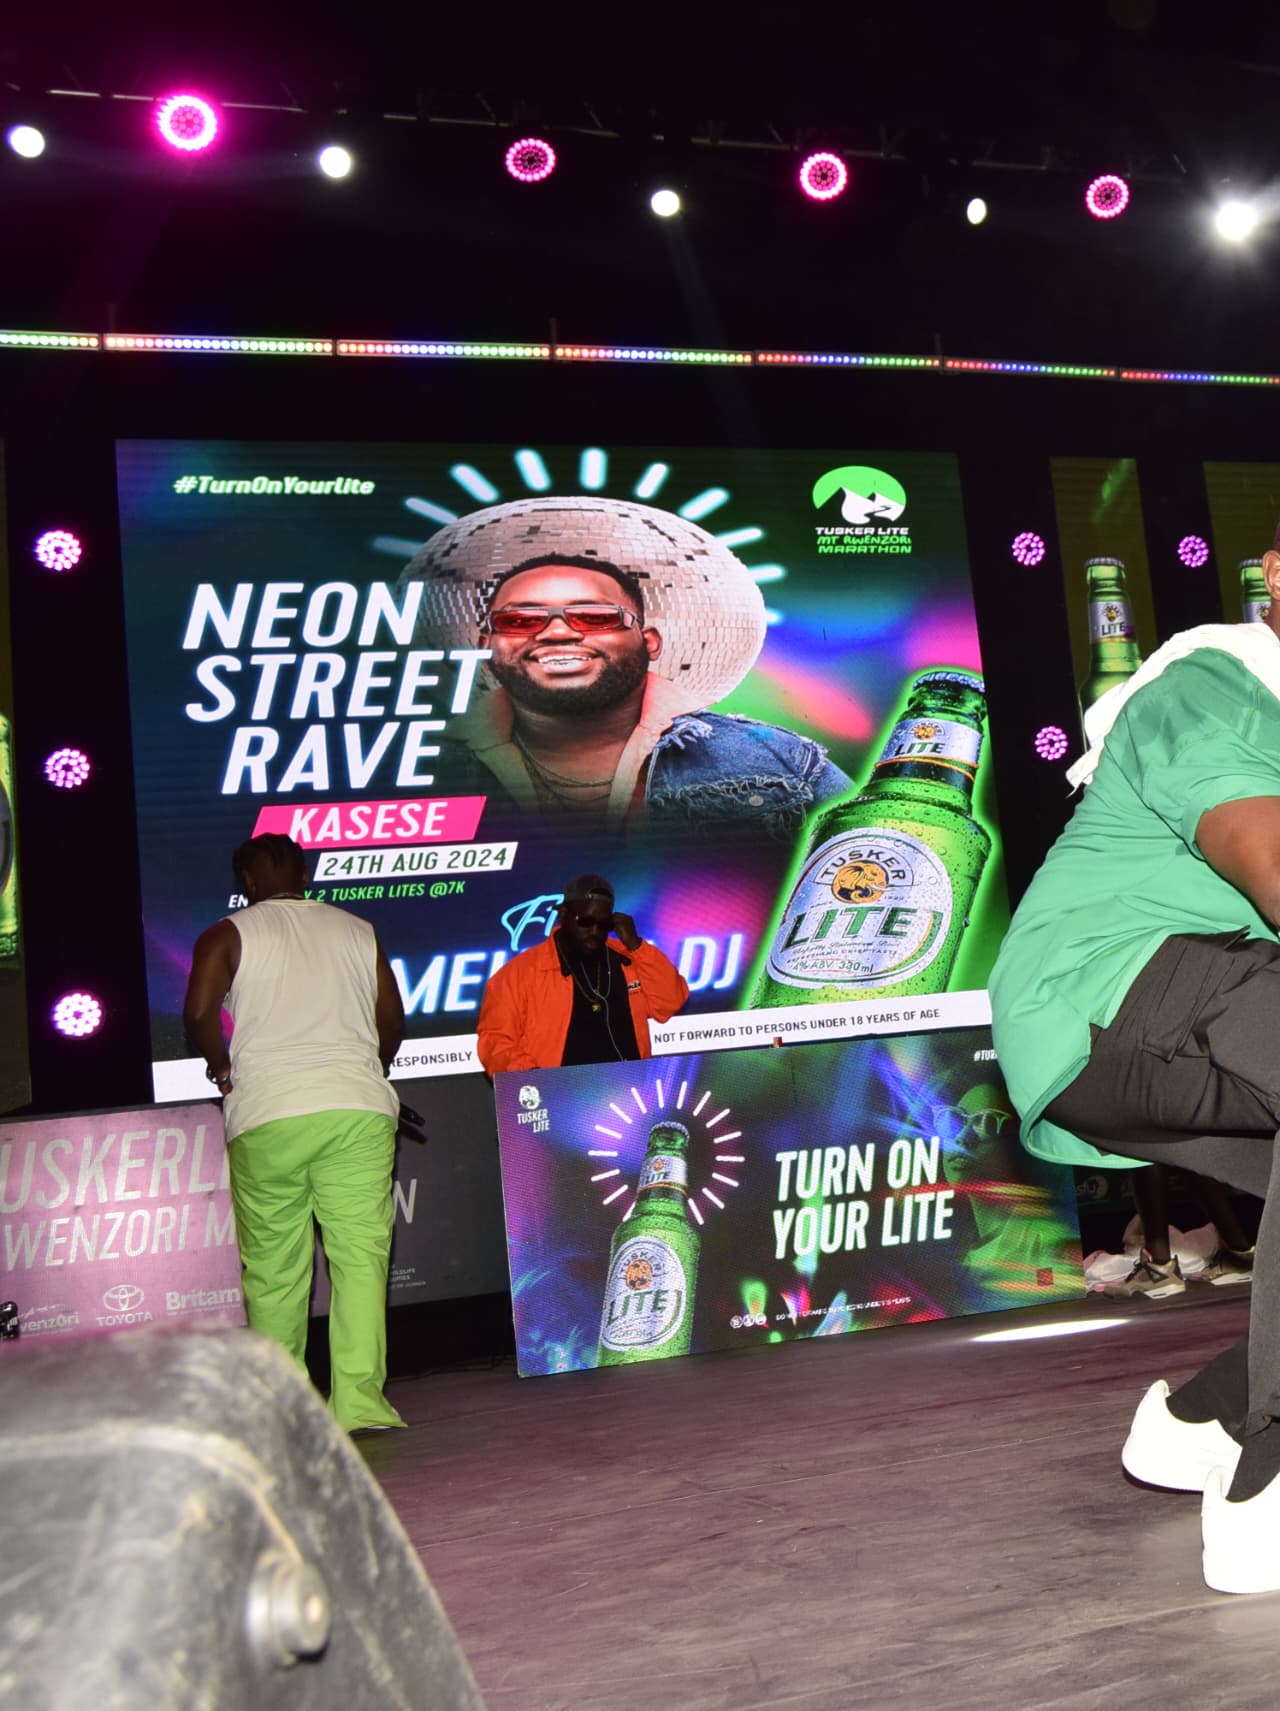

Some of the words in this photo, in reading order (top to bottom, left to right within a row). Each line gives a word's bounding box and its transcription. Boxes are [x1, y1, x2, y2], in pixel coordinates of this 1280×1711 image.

[815, 527, 875, 535] TUSKER
[878, 527, 909, 535] LITE
[817, 536, 840, 545] MT
[818, 545, 912, 554] MARATHON
[182, 581, 424, 649] NEON
[1102, 622, 1125, 636] LITE
[184, 649, 493, 723] STREET
[221, 720, 446, 794] RAVE
[895, 743, 945, 756] LITE
[289, 802, 448, 843] KASESE
[323, 853, 384, 876] 24TH
[391, 851, 438, 873] AUG
[446, 847, 508, 870] 2024
[820, 849, 908, 881] TUSKER
[316, 890, 327, 902] 2
[332, 886, 384, 901] TUSKER
[389, 884, 425, 899] LITES
[429, 881, 467, 897] @7K
[780, 905, 918, 952] LITE
[679, 933, 744, 992] DJ
[654, 1031, 677, 1043] NOT
[680, 1028, 736, 1041] FORWARD
[739, 1026, 753, 1035] TO
[756, 1020, 807, 1034] PERSONS
[810, 1016, 847, 1030] UNDER
[851, 1015, 864, 1026] 18
[866, 1012, 900, 1025] YEARS
[903, 1009, 918, 1021] OF
[920, 1008, 942, 1019] AGE
[517, 1109, 548, 1125] TUSKER
[533, 1120, 550, 1132] LITE
[644, 1171, 671, 1184] LITE
[774, 1142, 877, 1202] TURN
[886, 1136, 941, 1191] ON
[772, 1202, 868, 1260] YOUR
[880, 1189, 955, 1246] LITE
[619, 1250, 664, 1274] TUSKER
[165, 1287, 241, 1310] Britam
[607, 1288, 669, 1328] LITE
[96, 1311, 153, 1328] TOYOTA
